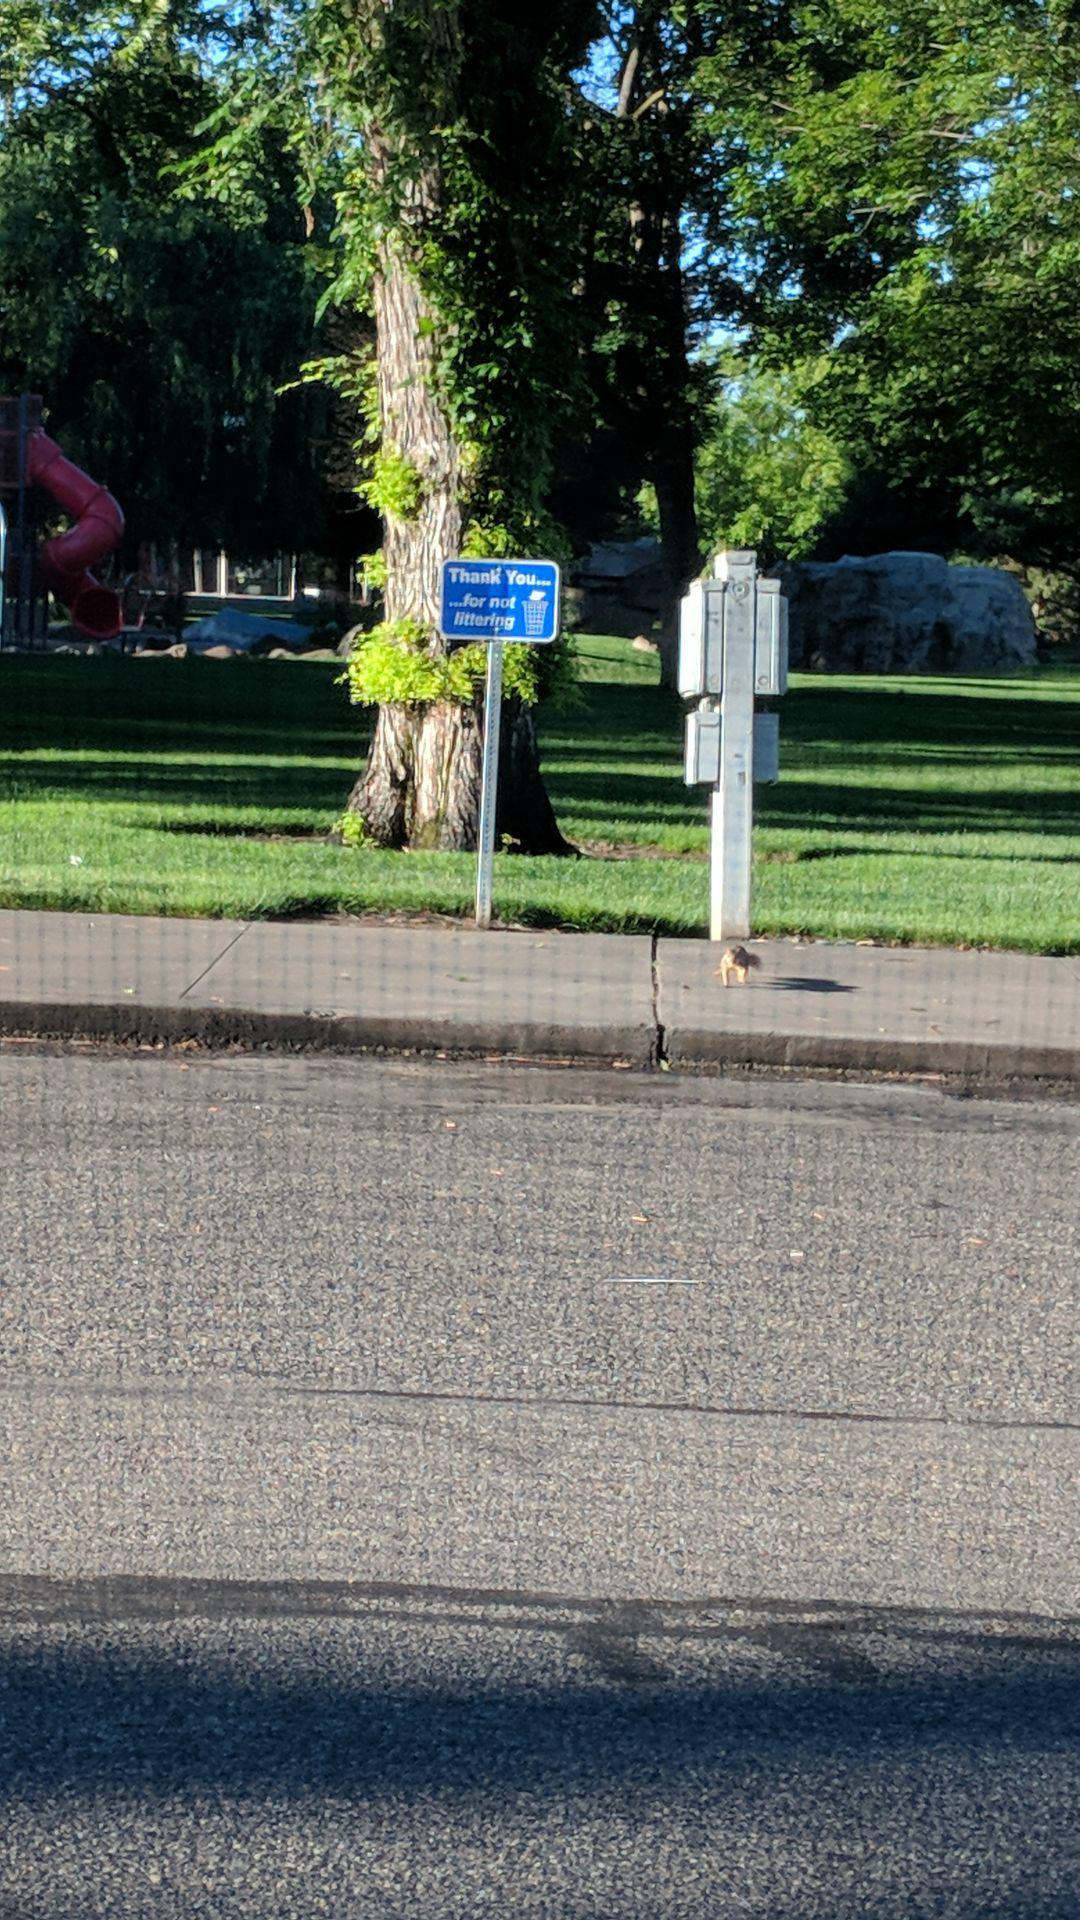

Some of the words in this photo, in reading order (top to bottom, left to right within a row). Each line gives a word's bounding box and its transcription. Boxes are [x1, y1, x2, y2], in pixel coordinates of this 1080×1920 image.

[448, 567, 502, 585] Thank
[489, 596, 516, 609] not
[453, 611, 516, 631] littering
